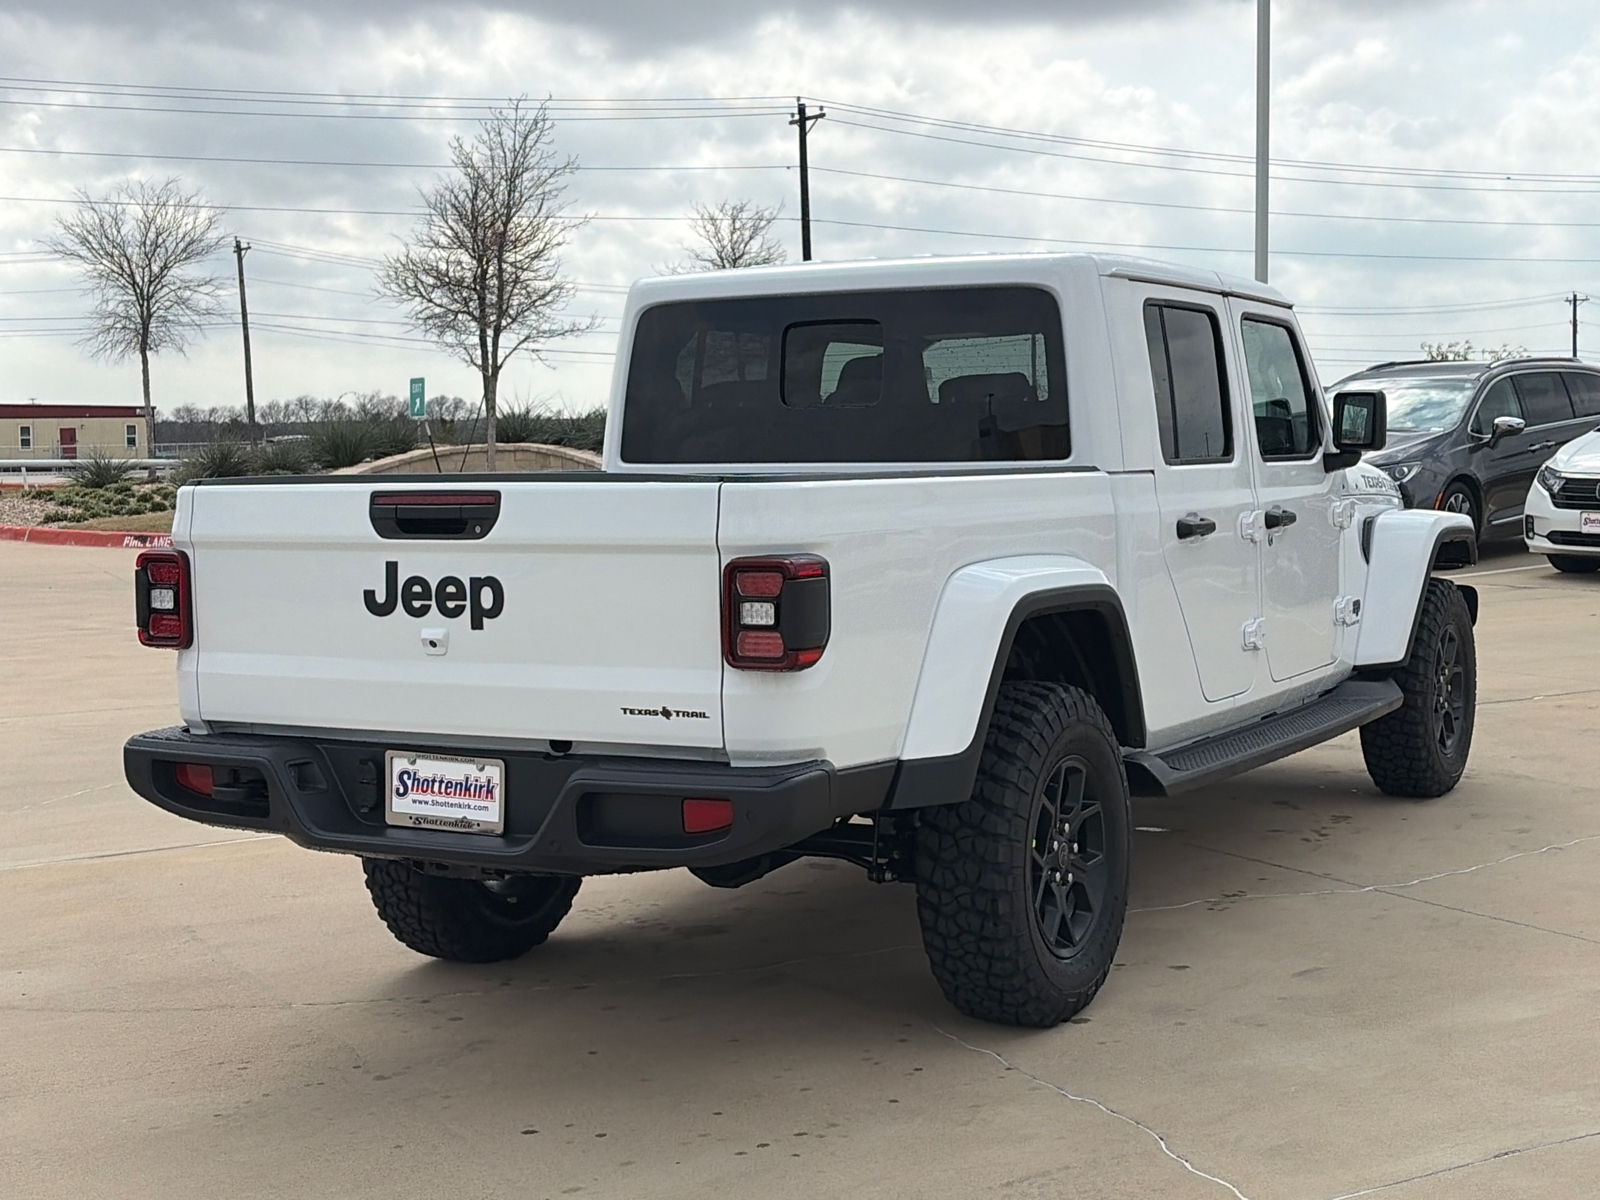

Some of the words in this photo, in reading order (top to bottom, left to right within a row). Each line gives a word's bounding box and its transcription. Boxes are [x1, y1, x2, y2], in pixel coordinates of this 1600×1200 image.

[412, 383, 422, 393] EXIT
[145, 536, 172, 548] LANE
[363, 561, 505, 630] Jeep
[620, 707, 659, 717] TEXAS
[673, 709, 710, 719] TRAIL
[395, 769, 497, 801] Shottenkirk
[411, 798, 490, 812] www.Shottenkirk.com
